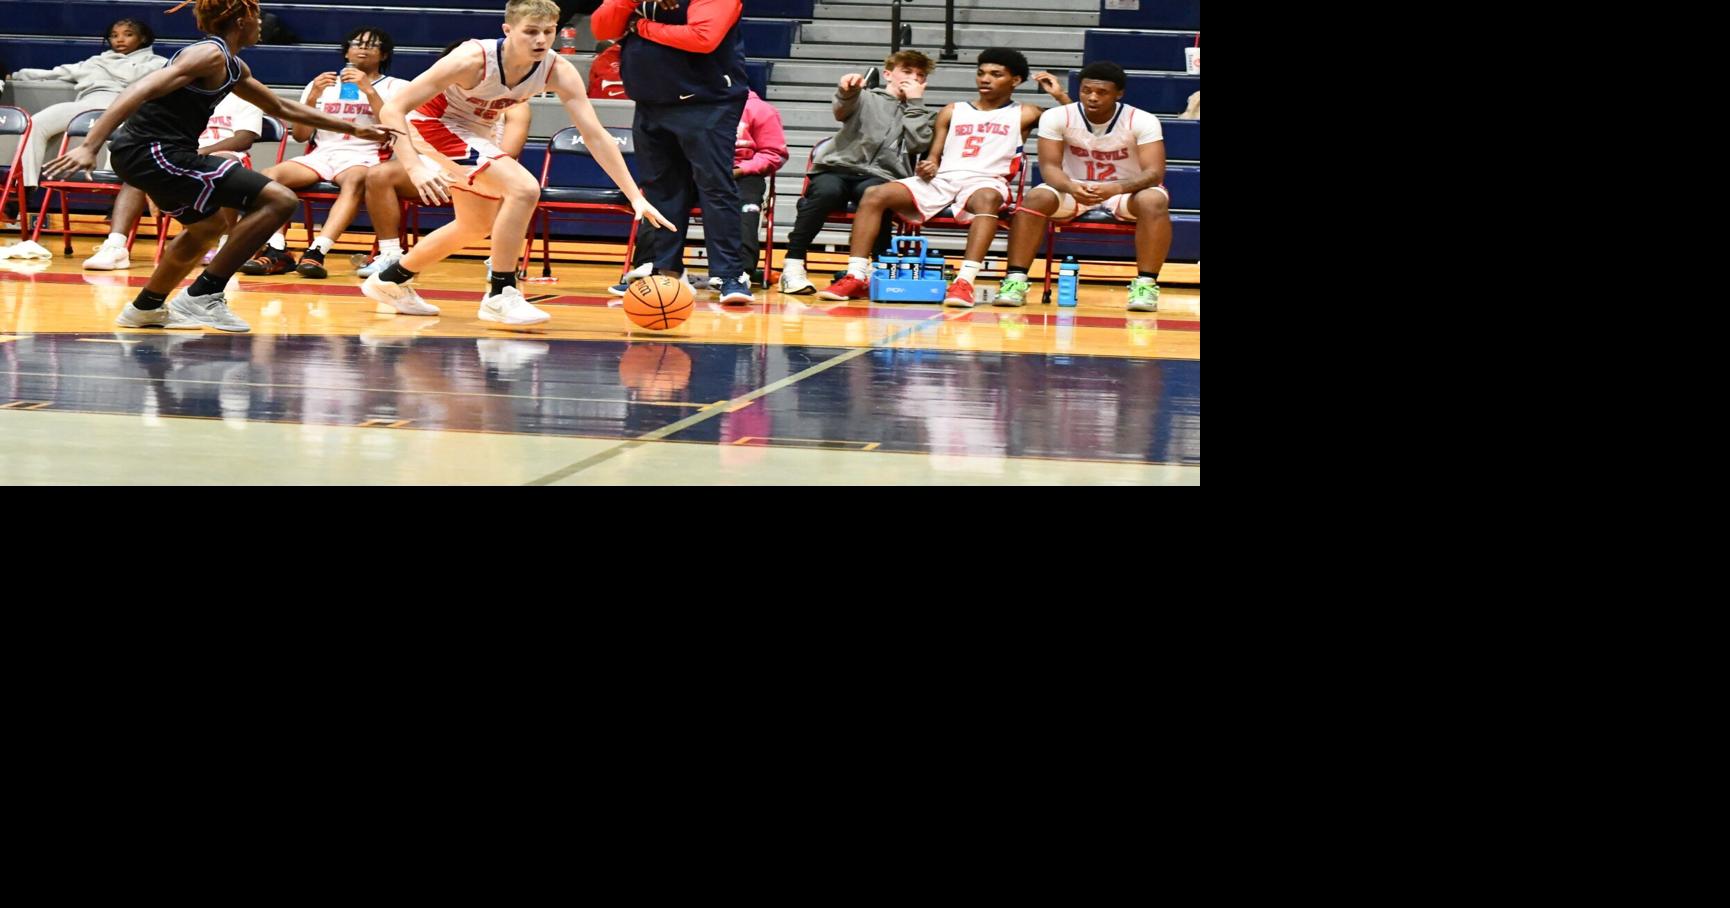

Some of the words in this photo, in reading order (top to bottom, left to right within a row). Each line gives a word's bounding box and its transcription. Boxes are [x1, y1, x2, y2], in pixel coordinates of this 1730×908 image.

[324, 102, 341, 114] RED
[342, 103, 374, 115] DEVIL
[208, 116, 232, 128] VILS
[955, 124, 974, 137] RED
[961, 135, 985, 158] 5
[1091, 147, 1129, 161] DEVILS
[1084, 160, 1118, 181] 12
[890, 263, 898, 280] POWE
[912, 263, 920, 280] POWE
